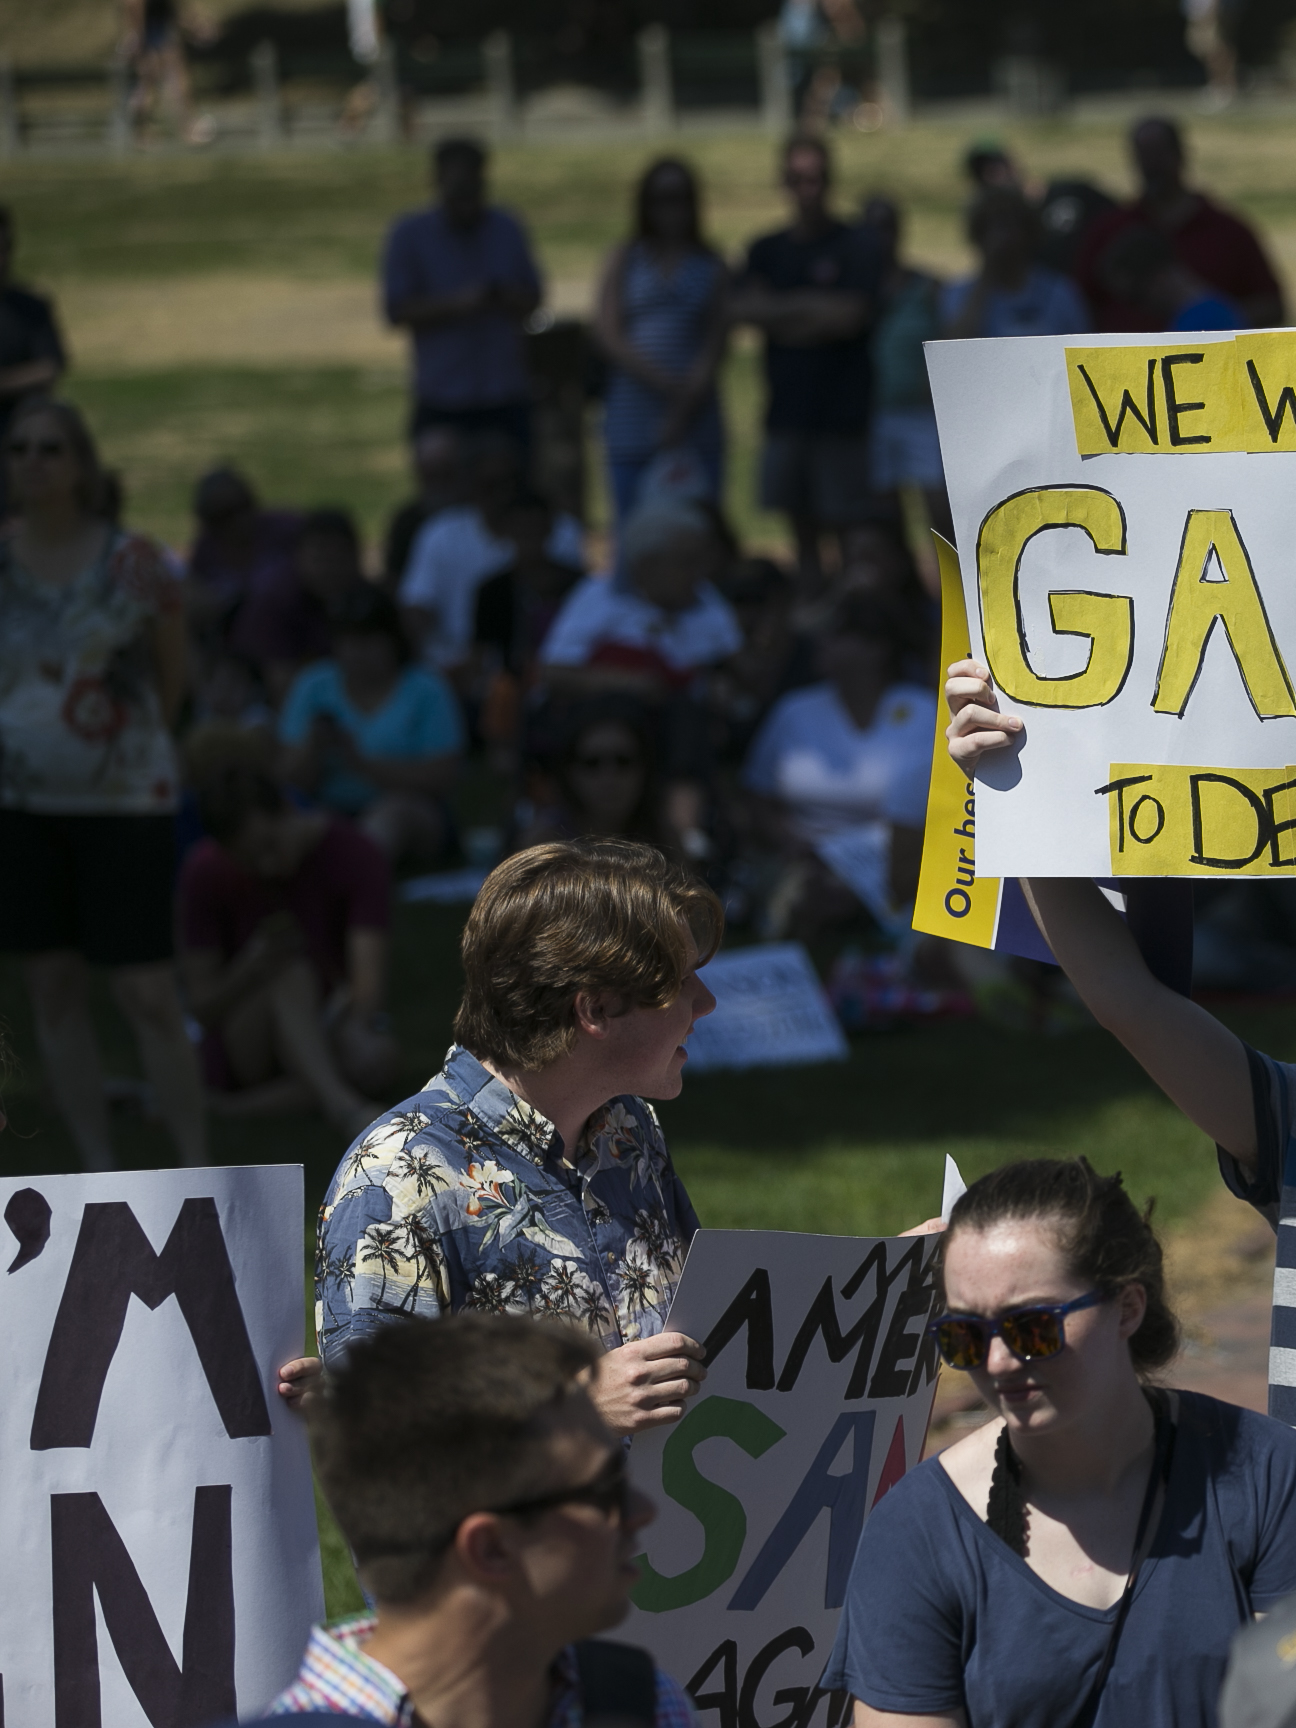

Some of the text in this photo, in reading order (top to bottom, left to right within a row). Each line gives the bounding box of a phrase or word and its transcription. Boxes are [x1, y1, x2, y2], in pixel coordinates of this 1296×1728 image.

[1077, 351, 1212, 449] WE
[944, 779, 975, 918] Our bes
[702, 1266, 946, 1401] AMER
[839, 1236, 946, 1300] MA
[630, 1394, 908, 1614] SA
[0, 1484, 239, 1728] N
